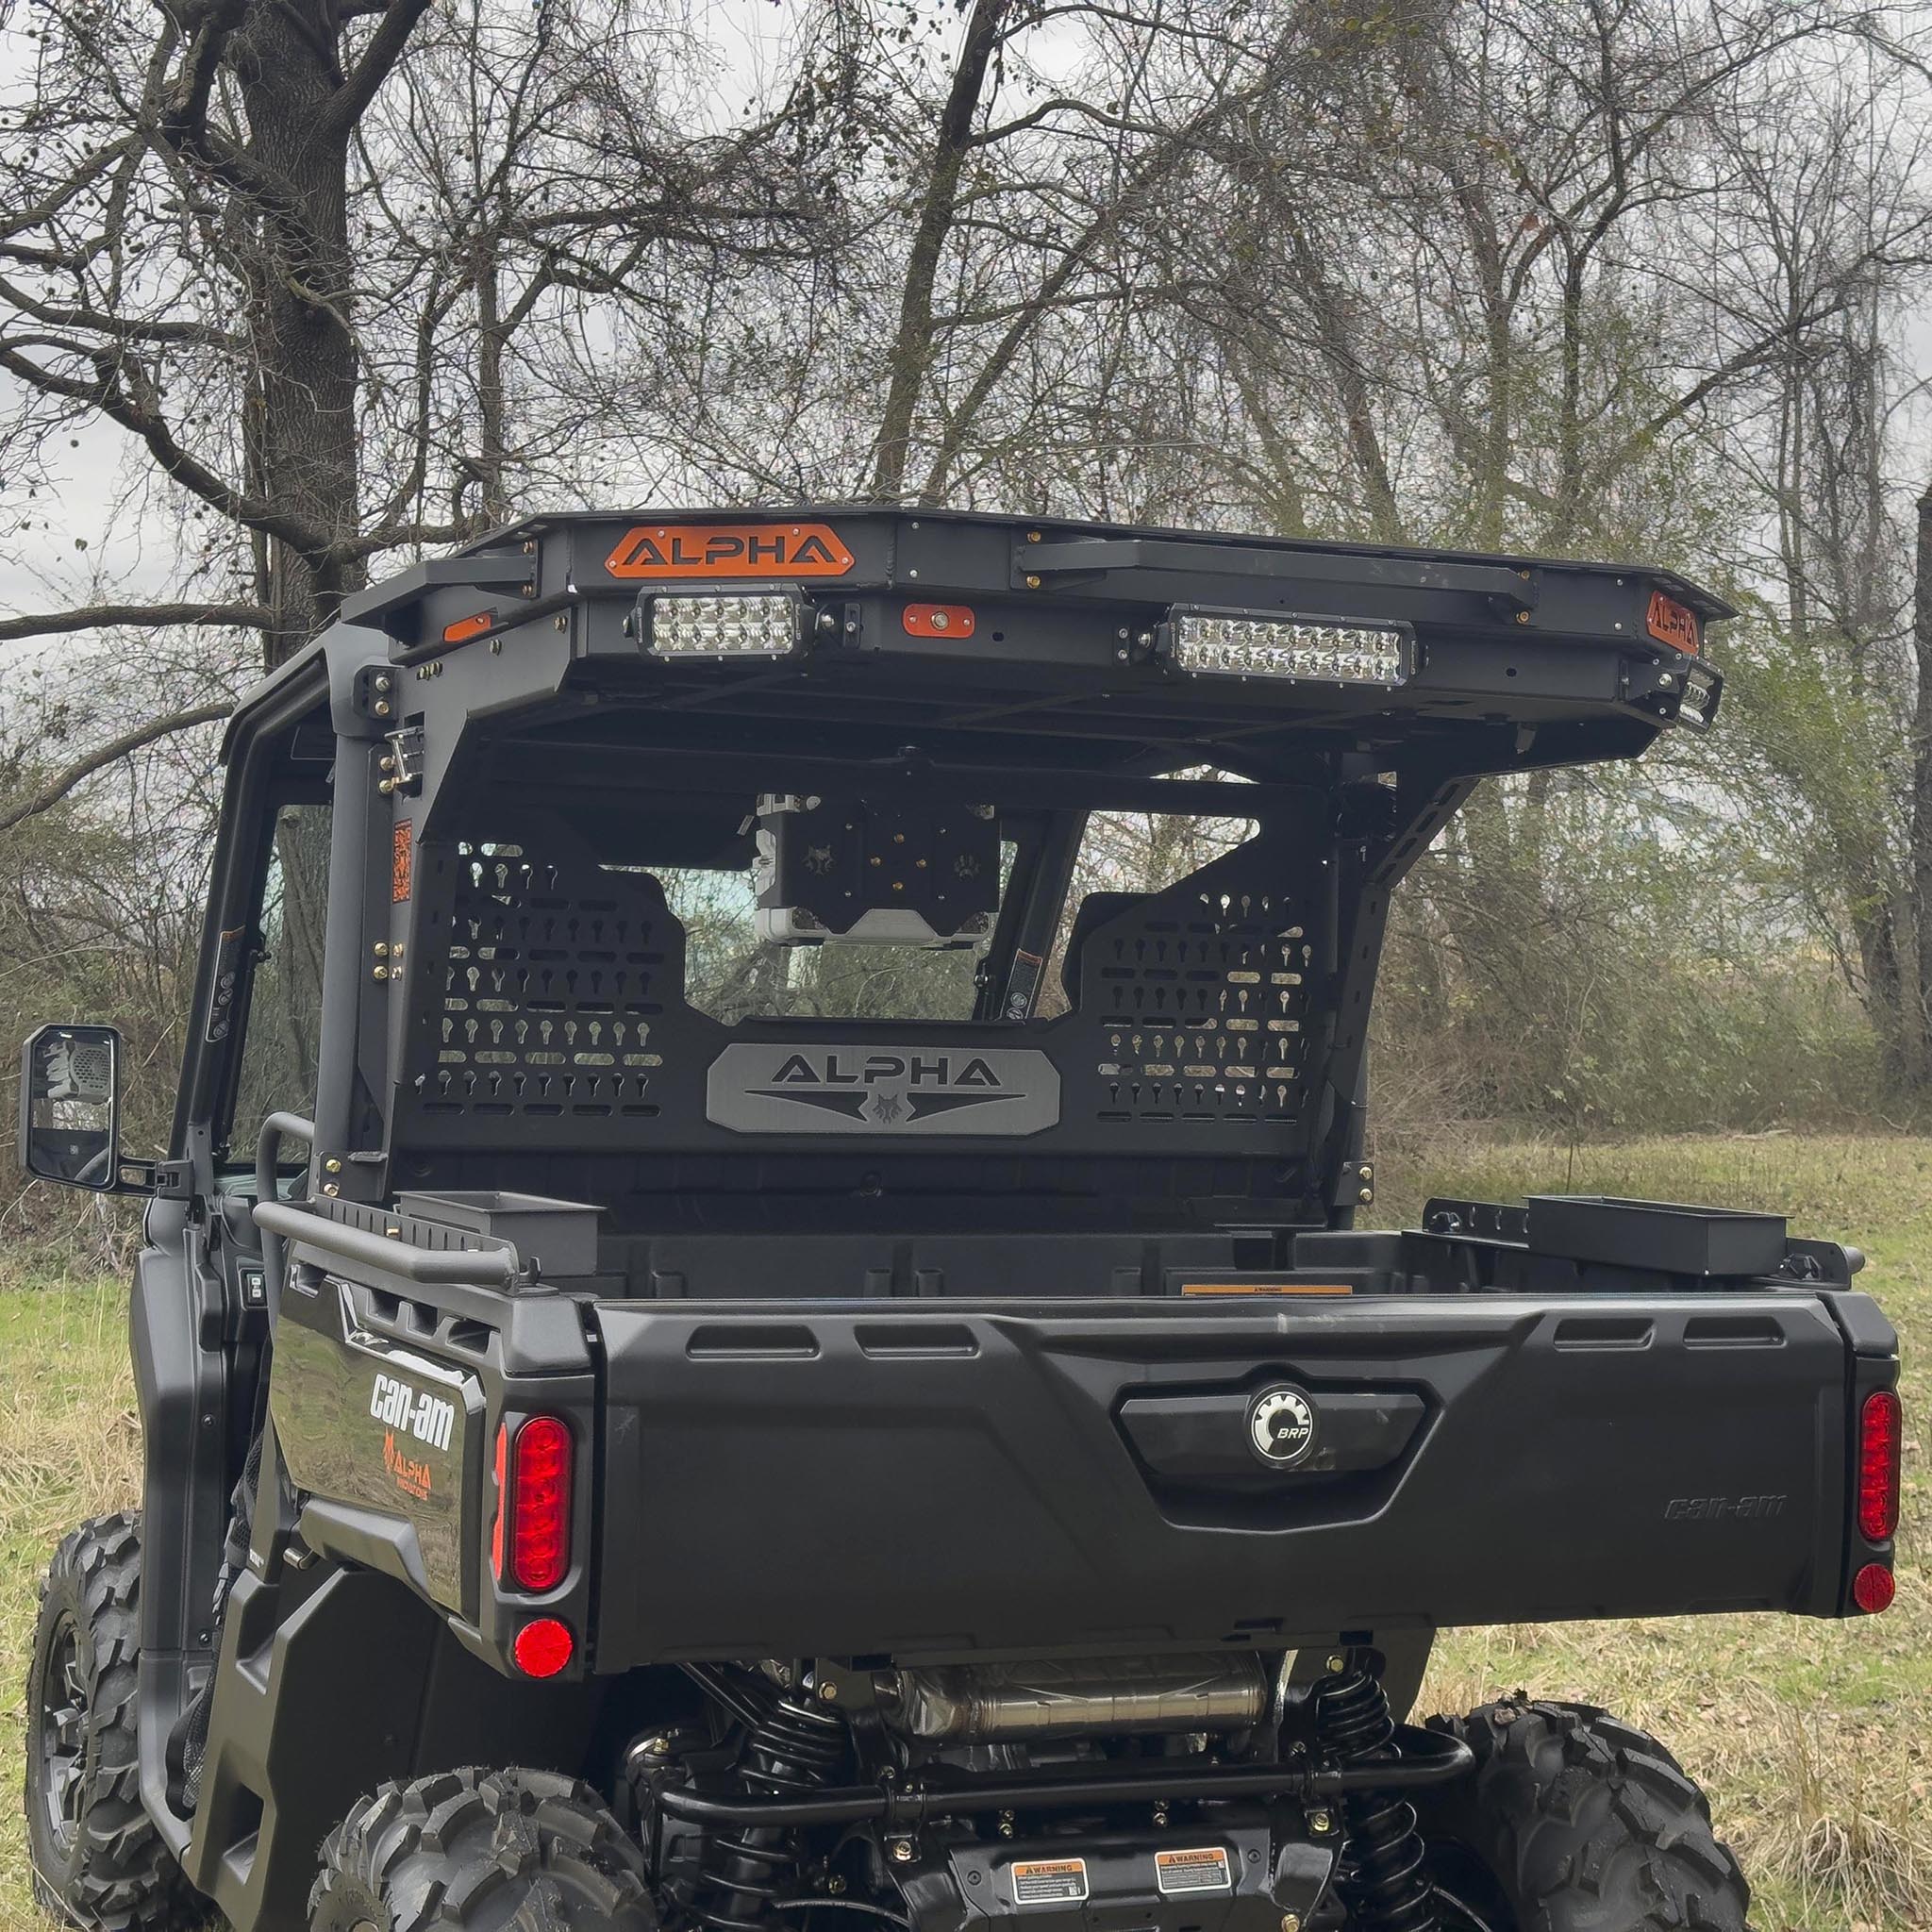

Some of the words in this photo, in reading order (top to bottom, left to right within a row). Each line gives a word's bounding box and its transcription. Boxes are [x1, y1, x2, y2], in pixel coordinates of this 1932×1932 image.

[623, 535, 838, 566] ALPHA
[1651, 602, 1696, 647] ALPHA
[771, 1054, 1002, 1087] ALPHA
[370, 1374, 455, 1452] can-am
[1276, 1427, 1309, 1440] BRP
[393, 1449, 431, 1491] ALPHA
[1663, 1494, 1789, 1520] can-am
[1032, 1864, 1073, 1874] WARNING
[1175, 1853, 1215, 1863] WARNING
